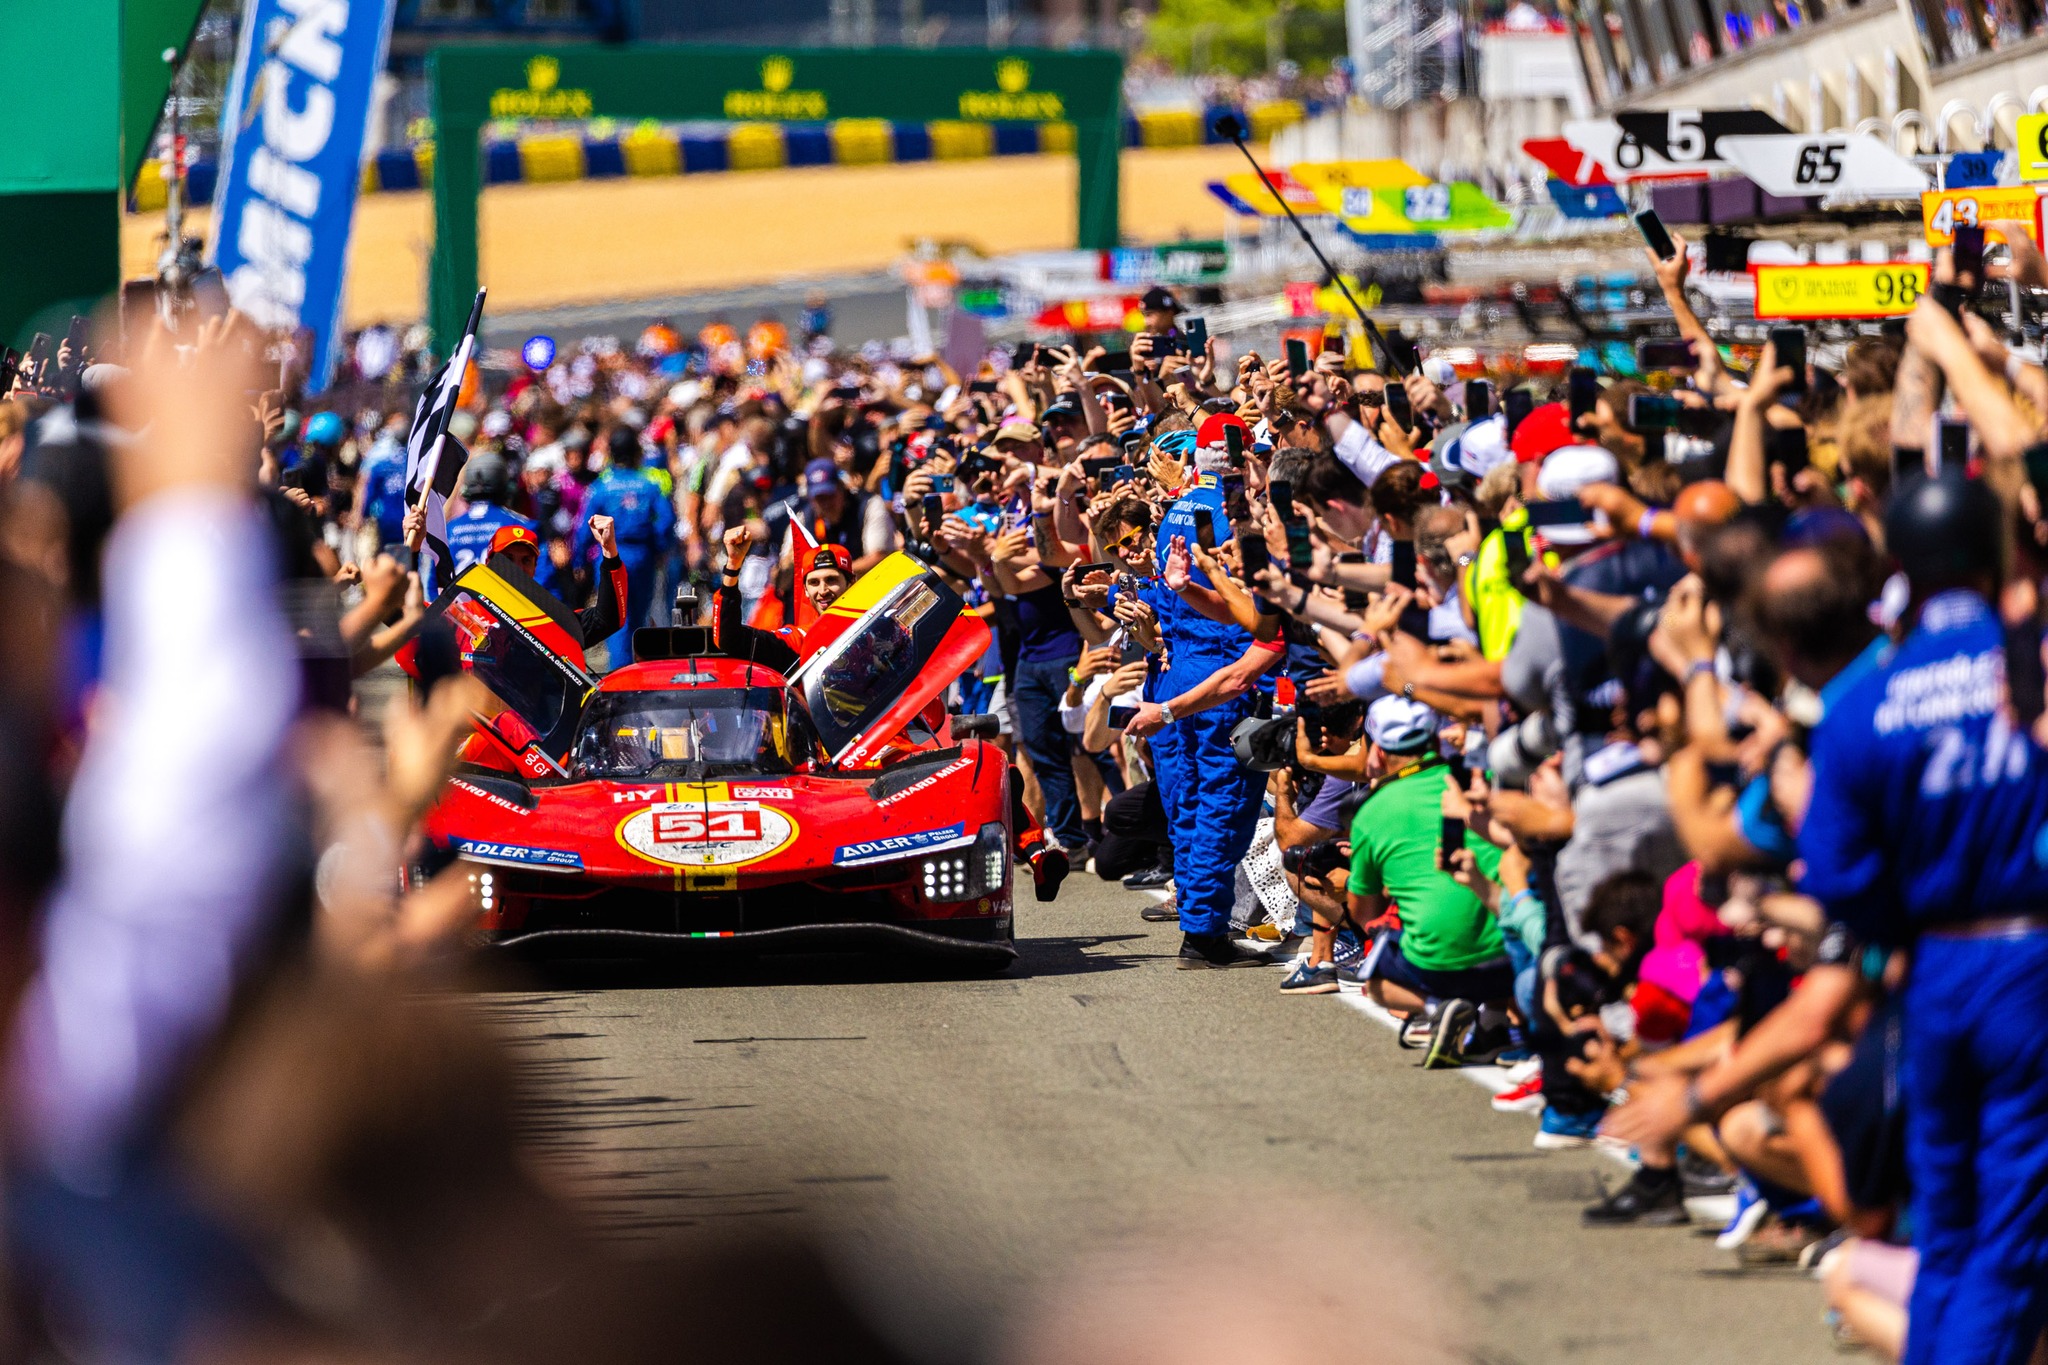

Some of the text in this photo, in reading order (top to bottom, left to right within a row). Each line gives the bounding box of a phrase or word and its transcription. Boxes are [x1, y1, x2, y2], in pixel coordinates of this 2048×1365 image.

[1667, 107, 1706, 161] 5
[1795, 145, 1846, 184] 65
[1932, 198, 1978, 236] 43
[1875, 270, 1917, 306] 98
[489, 603, 501, 615] PIER
[500, 612, 516, 627] GUIDI
[523, 632, 545, 653] CALADO
[554, 659, 583, 687] GIOVINAZZI
[448, 777, 531, 816] HARD MILLE
[614, 789, 657, 803] HY
[876, 757, 974, 808] RICHARD MILLE
[659, 813, 756, 839] 51
[458, 842, 529, 858] ADLER
[843, 837, 912, 858] ADLER
